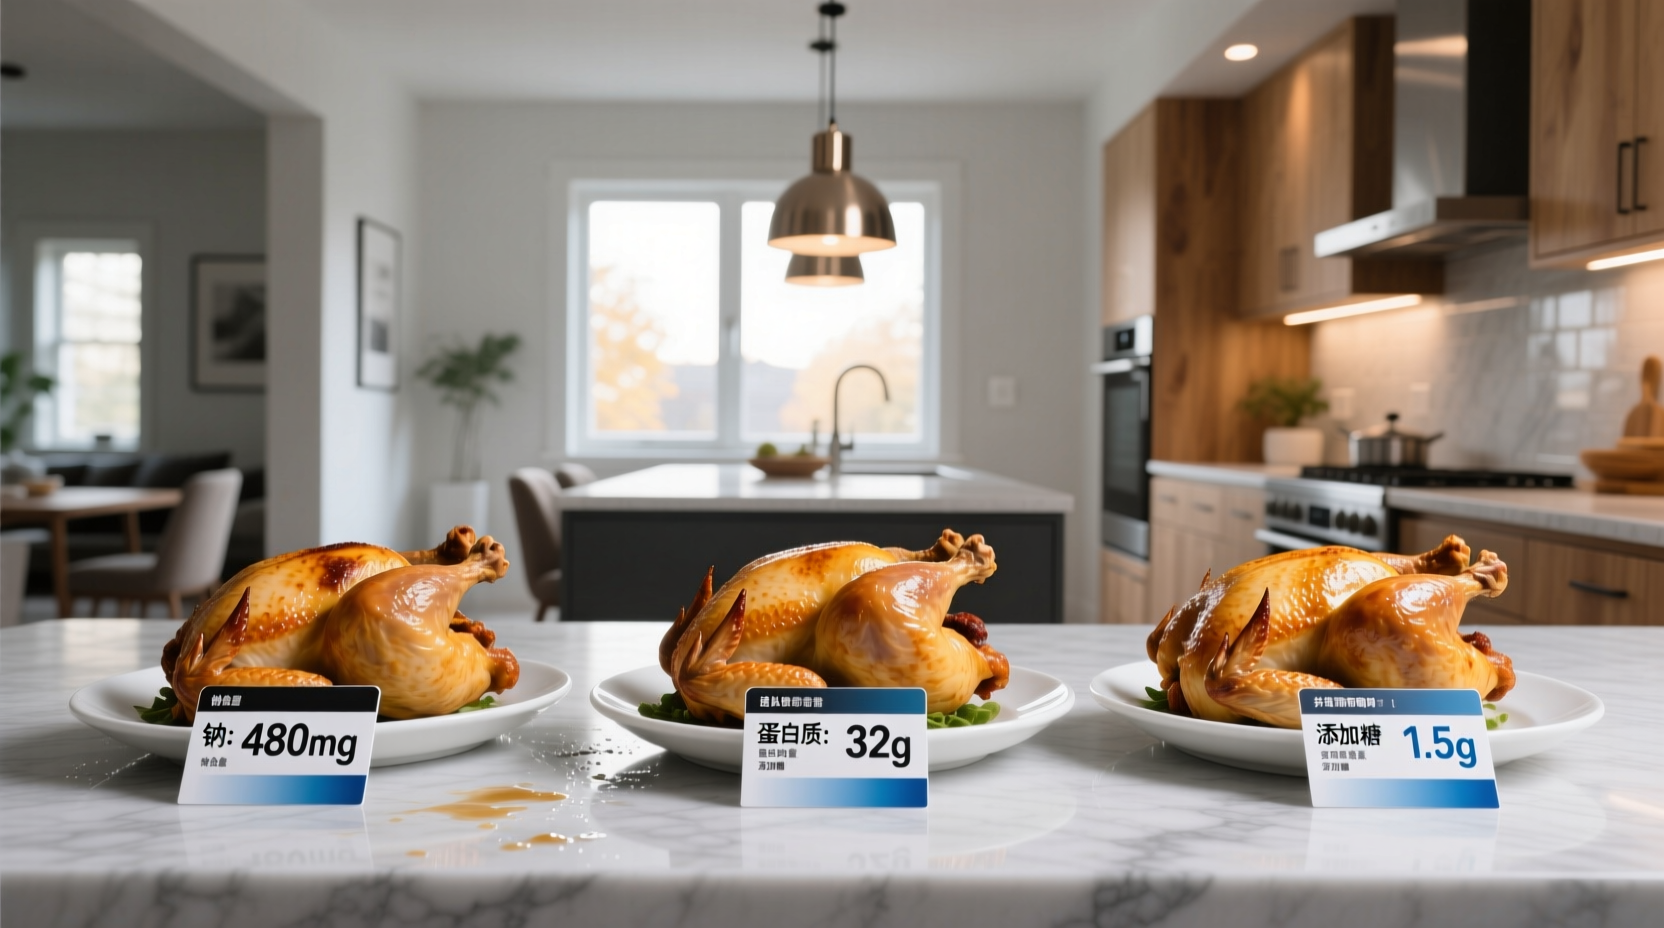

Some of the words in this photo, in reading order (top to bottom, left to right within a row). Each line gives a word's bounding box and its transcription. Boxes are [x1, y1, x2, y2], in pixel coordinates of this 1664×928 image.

[202, 722, 234, 749] 钠:
[241, 722, 358, 766] 480mg
[757, 721, 829, 745] 蛋白质:
[845, 724, 911, 768] 32g
[1316, 722, 1382, 746] 添加糖
[1403, 725, 1477, 769] 1.5g
